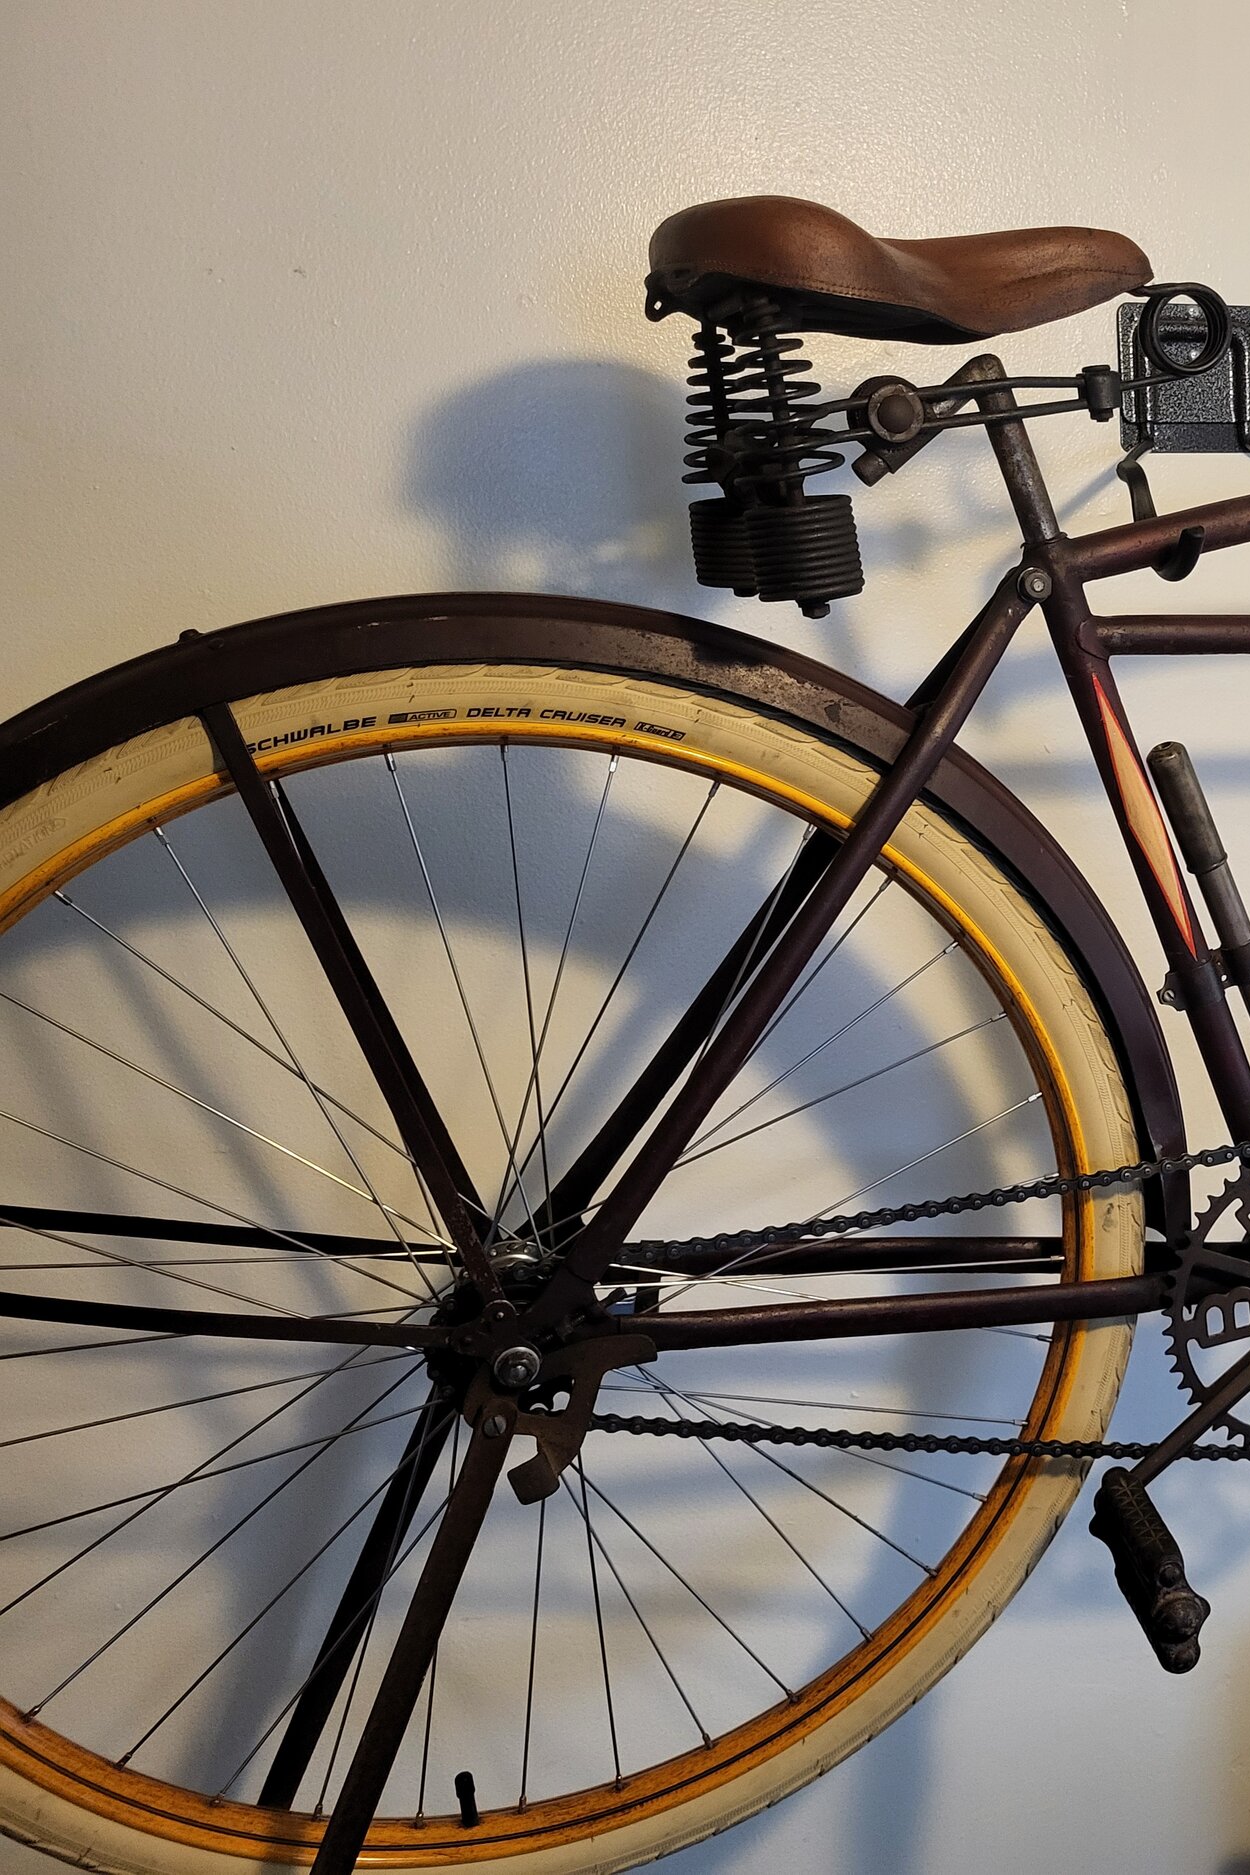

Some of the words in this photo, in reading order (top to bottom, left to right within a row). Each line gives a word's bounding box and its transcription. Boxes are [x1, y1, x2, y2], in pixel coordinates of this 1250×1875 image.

[246, 716, 377, 755] SCHWALBE
[408, 710, 450, 721] ACTIVE
[466, 707, 532, 718] DELTA
[539, 708, 627, 728] CRUISER
